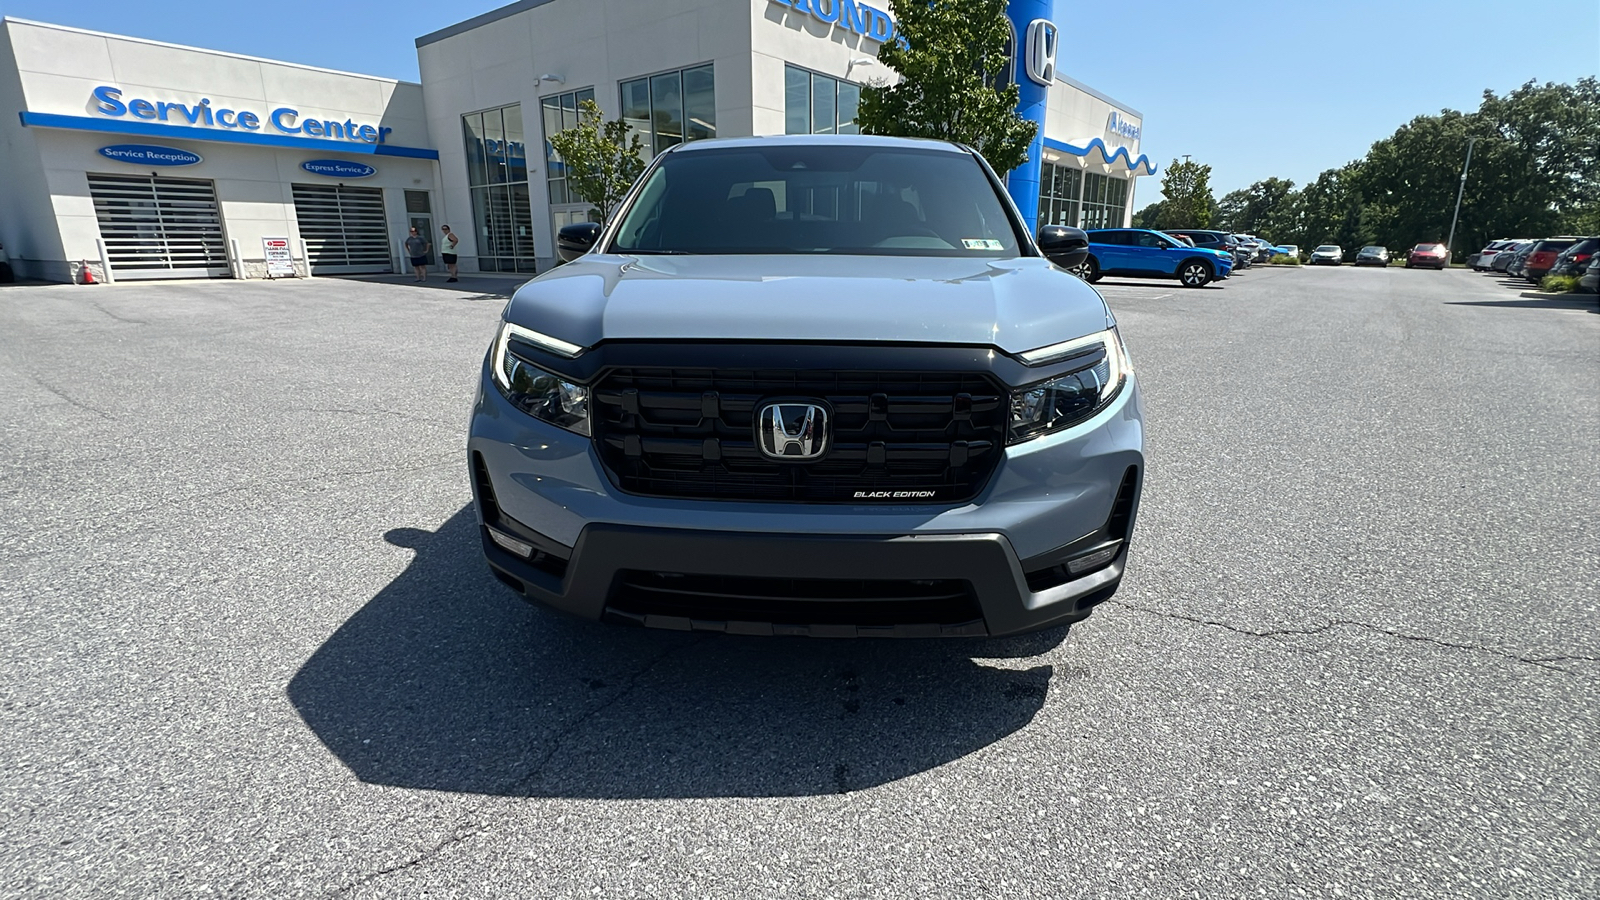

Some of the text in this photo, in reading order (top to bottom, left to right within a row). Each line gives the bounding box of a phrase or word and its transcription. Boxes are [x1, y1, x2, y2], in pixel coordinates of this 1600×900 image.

[93, 85, 392, 144] Service Center
[104, 148, 196, 162] Service Reception
[305, 163, 361, 173] Express Service
